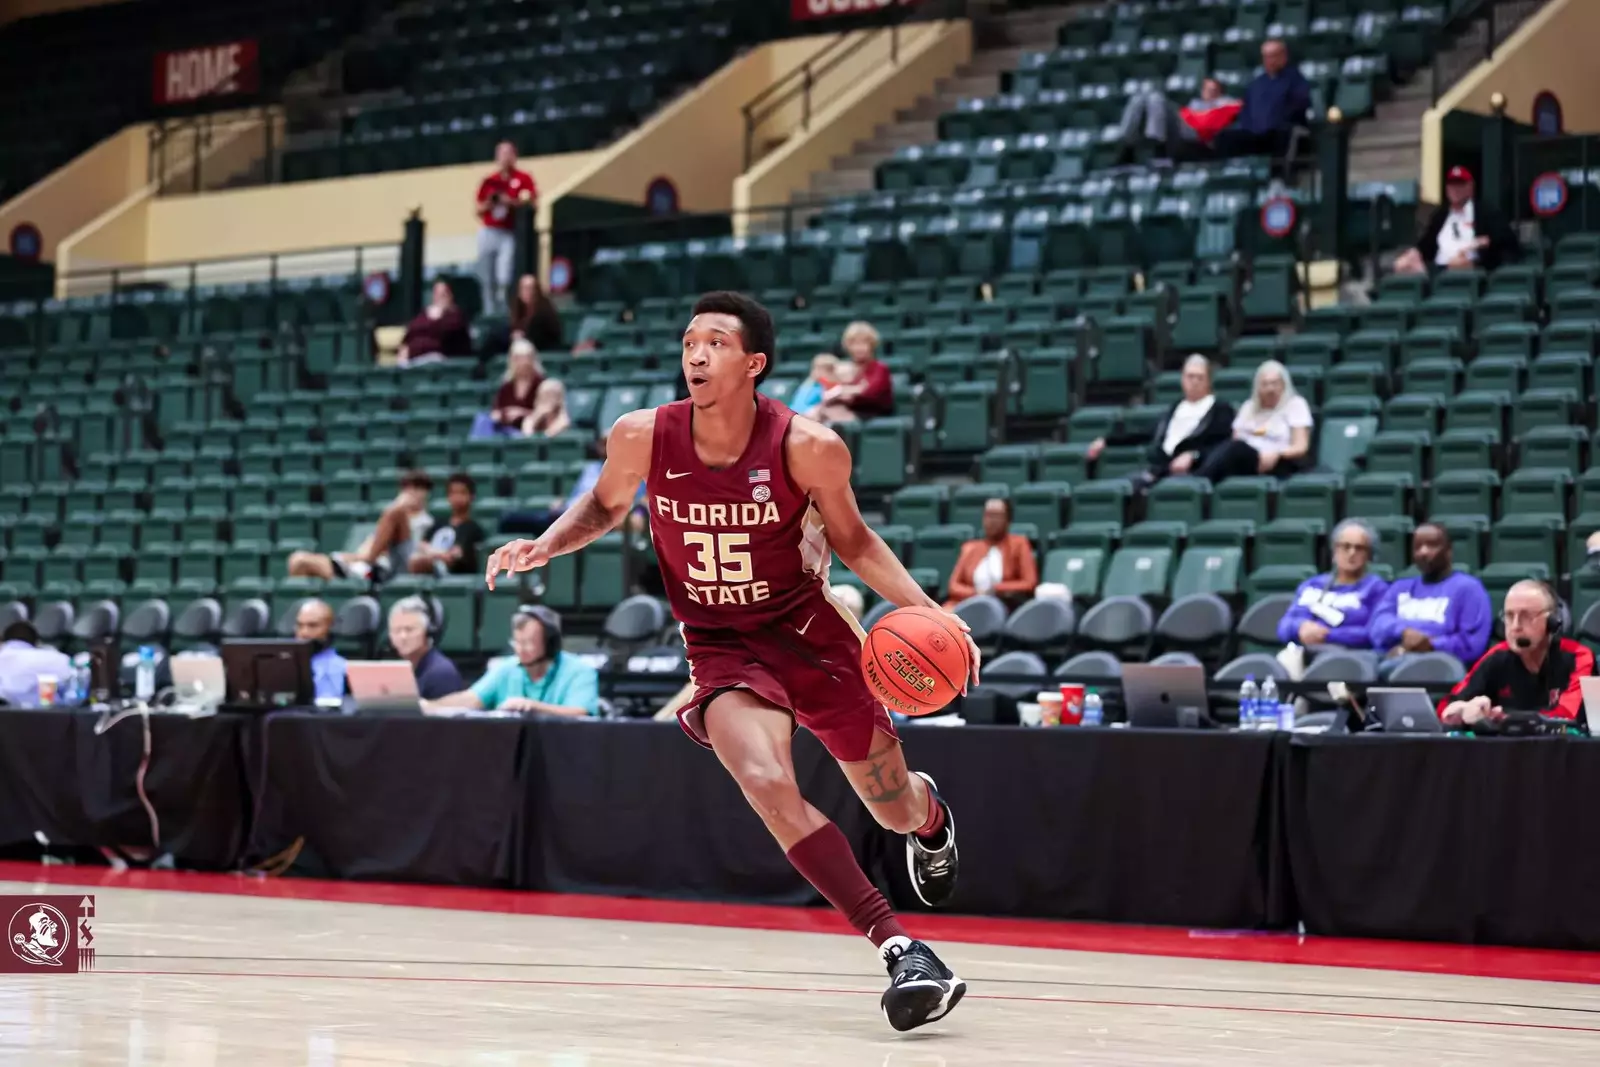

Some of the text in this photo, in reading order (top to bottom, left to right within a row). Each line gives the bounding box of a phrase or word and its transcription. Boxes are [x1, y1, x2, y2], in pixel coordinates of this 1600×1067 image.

[166, 43, 241, 100] HOME
[655, 495, 780, 527] FLORIDA
[683, 531, 753, 582] 35
[683, 580, 770, 606] STATE
[884, 651, 935, 697] LEGACY
[895, 649, 926, 678] 1000
